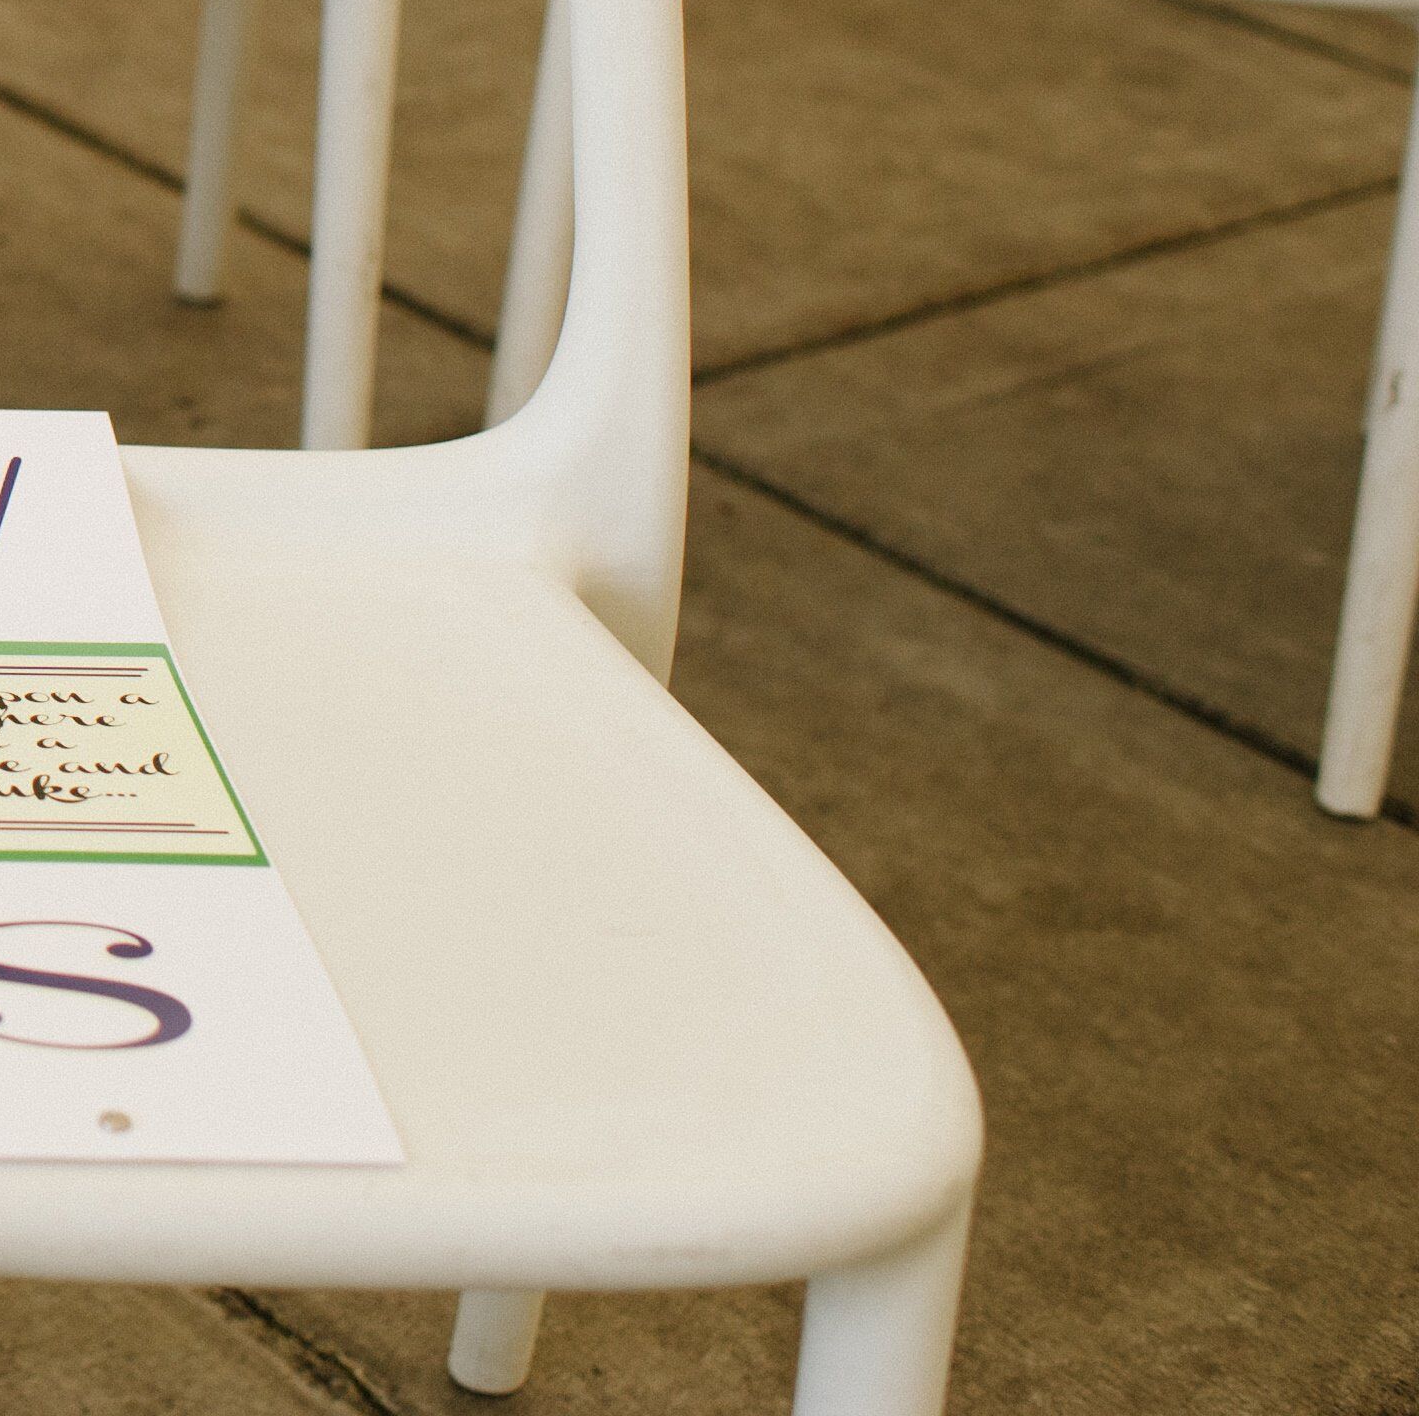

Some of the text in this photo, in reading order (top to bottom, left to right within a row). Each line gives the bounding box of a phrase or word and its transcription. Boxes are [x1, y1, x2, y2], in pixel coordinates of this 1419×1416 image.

[119, 691, 160, 705] a
[36, 734, 77, 749] a
[58, 753, 182, 776] and
